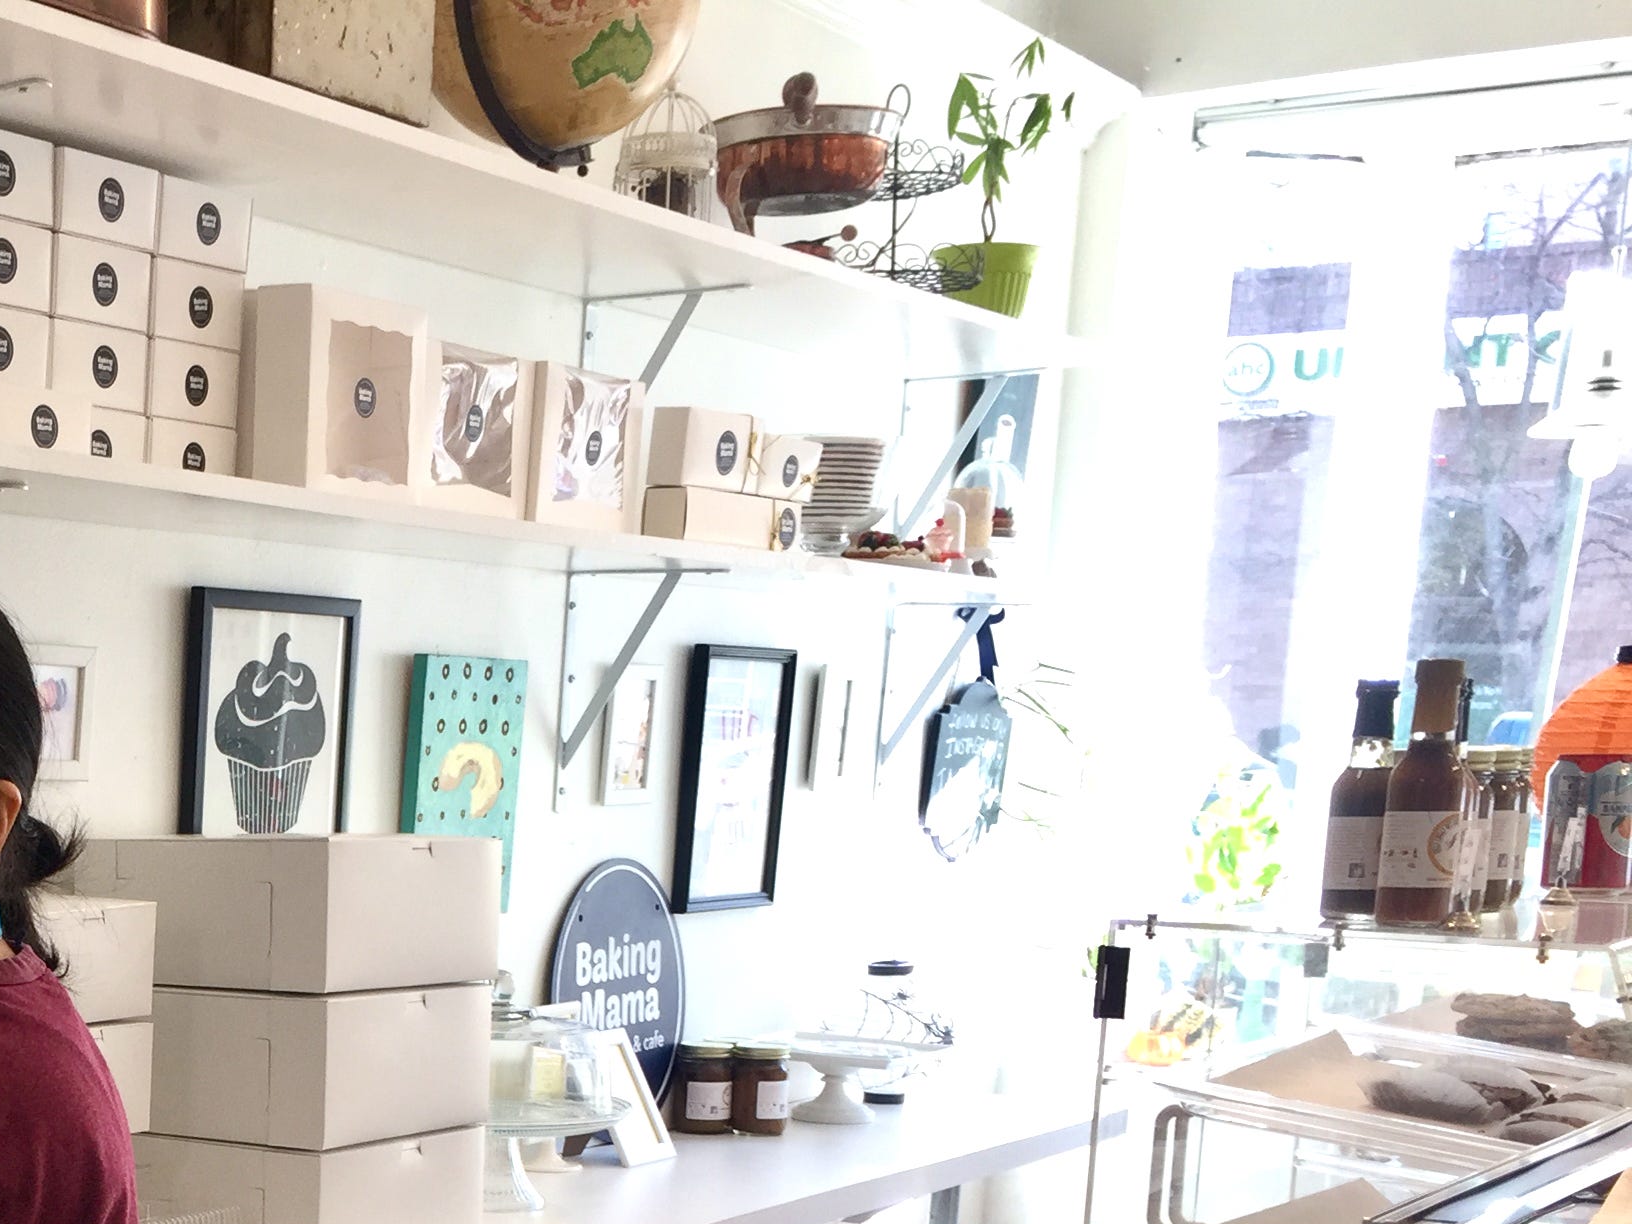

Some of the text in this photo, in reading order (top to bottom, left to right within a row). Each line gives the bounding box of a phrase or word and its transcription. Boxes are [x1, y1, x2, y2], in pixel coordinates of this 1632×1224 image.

[576, 933, 661, 986] Baking
[582, 987, 660, 1031] Mama
[633, 1035, 642, 1052] &
